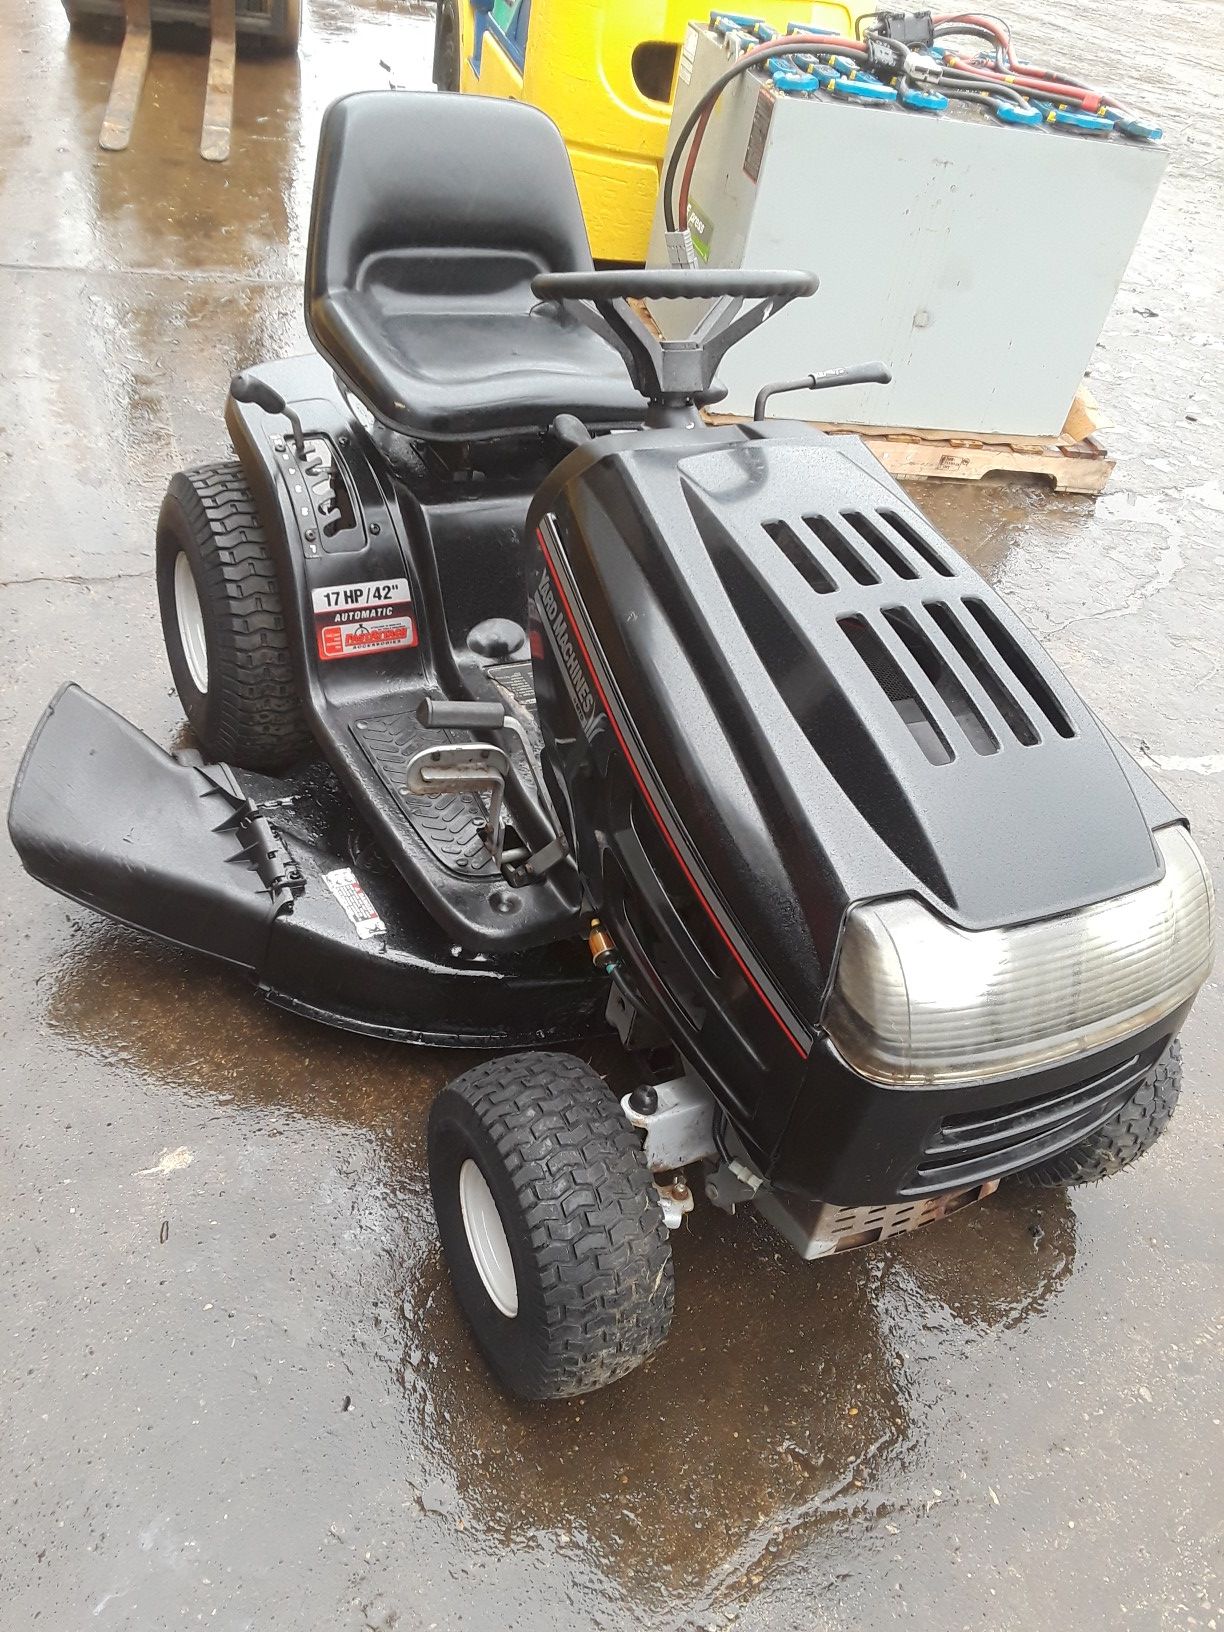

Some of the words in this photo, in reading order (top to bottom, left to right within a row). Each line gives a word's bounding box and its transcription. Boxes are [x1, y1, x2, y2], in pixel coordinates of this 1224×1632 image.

[323, 591, 340, 607] 17
[343, 588, 364, 605] HP
[334, 606, 393, 622] AUTOMATIC
[538, 567, 558, 621] YARD
[552, 612, 594, 713] MACHINES
